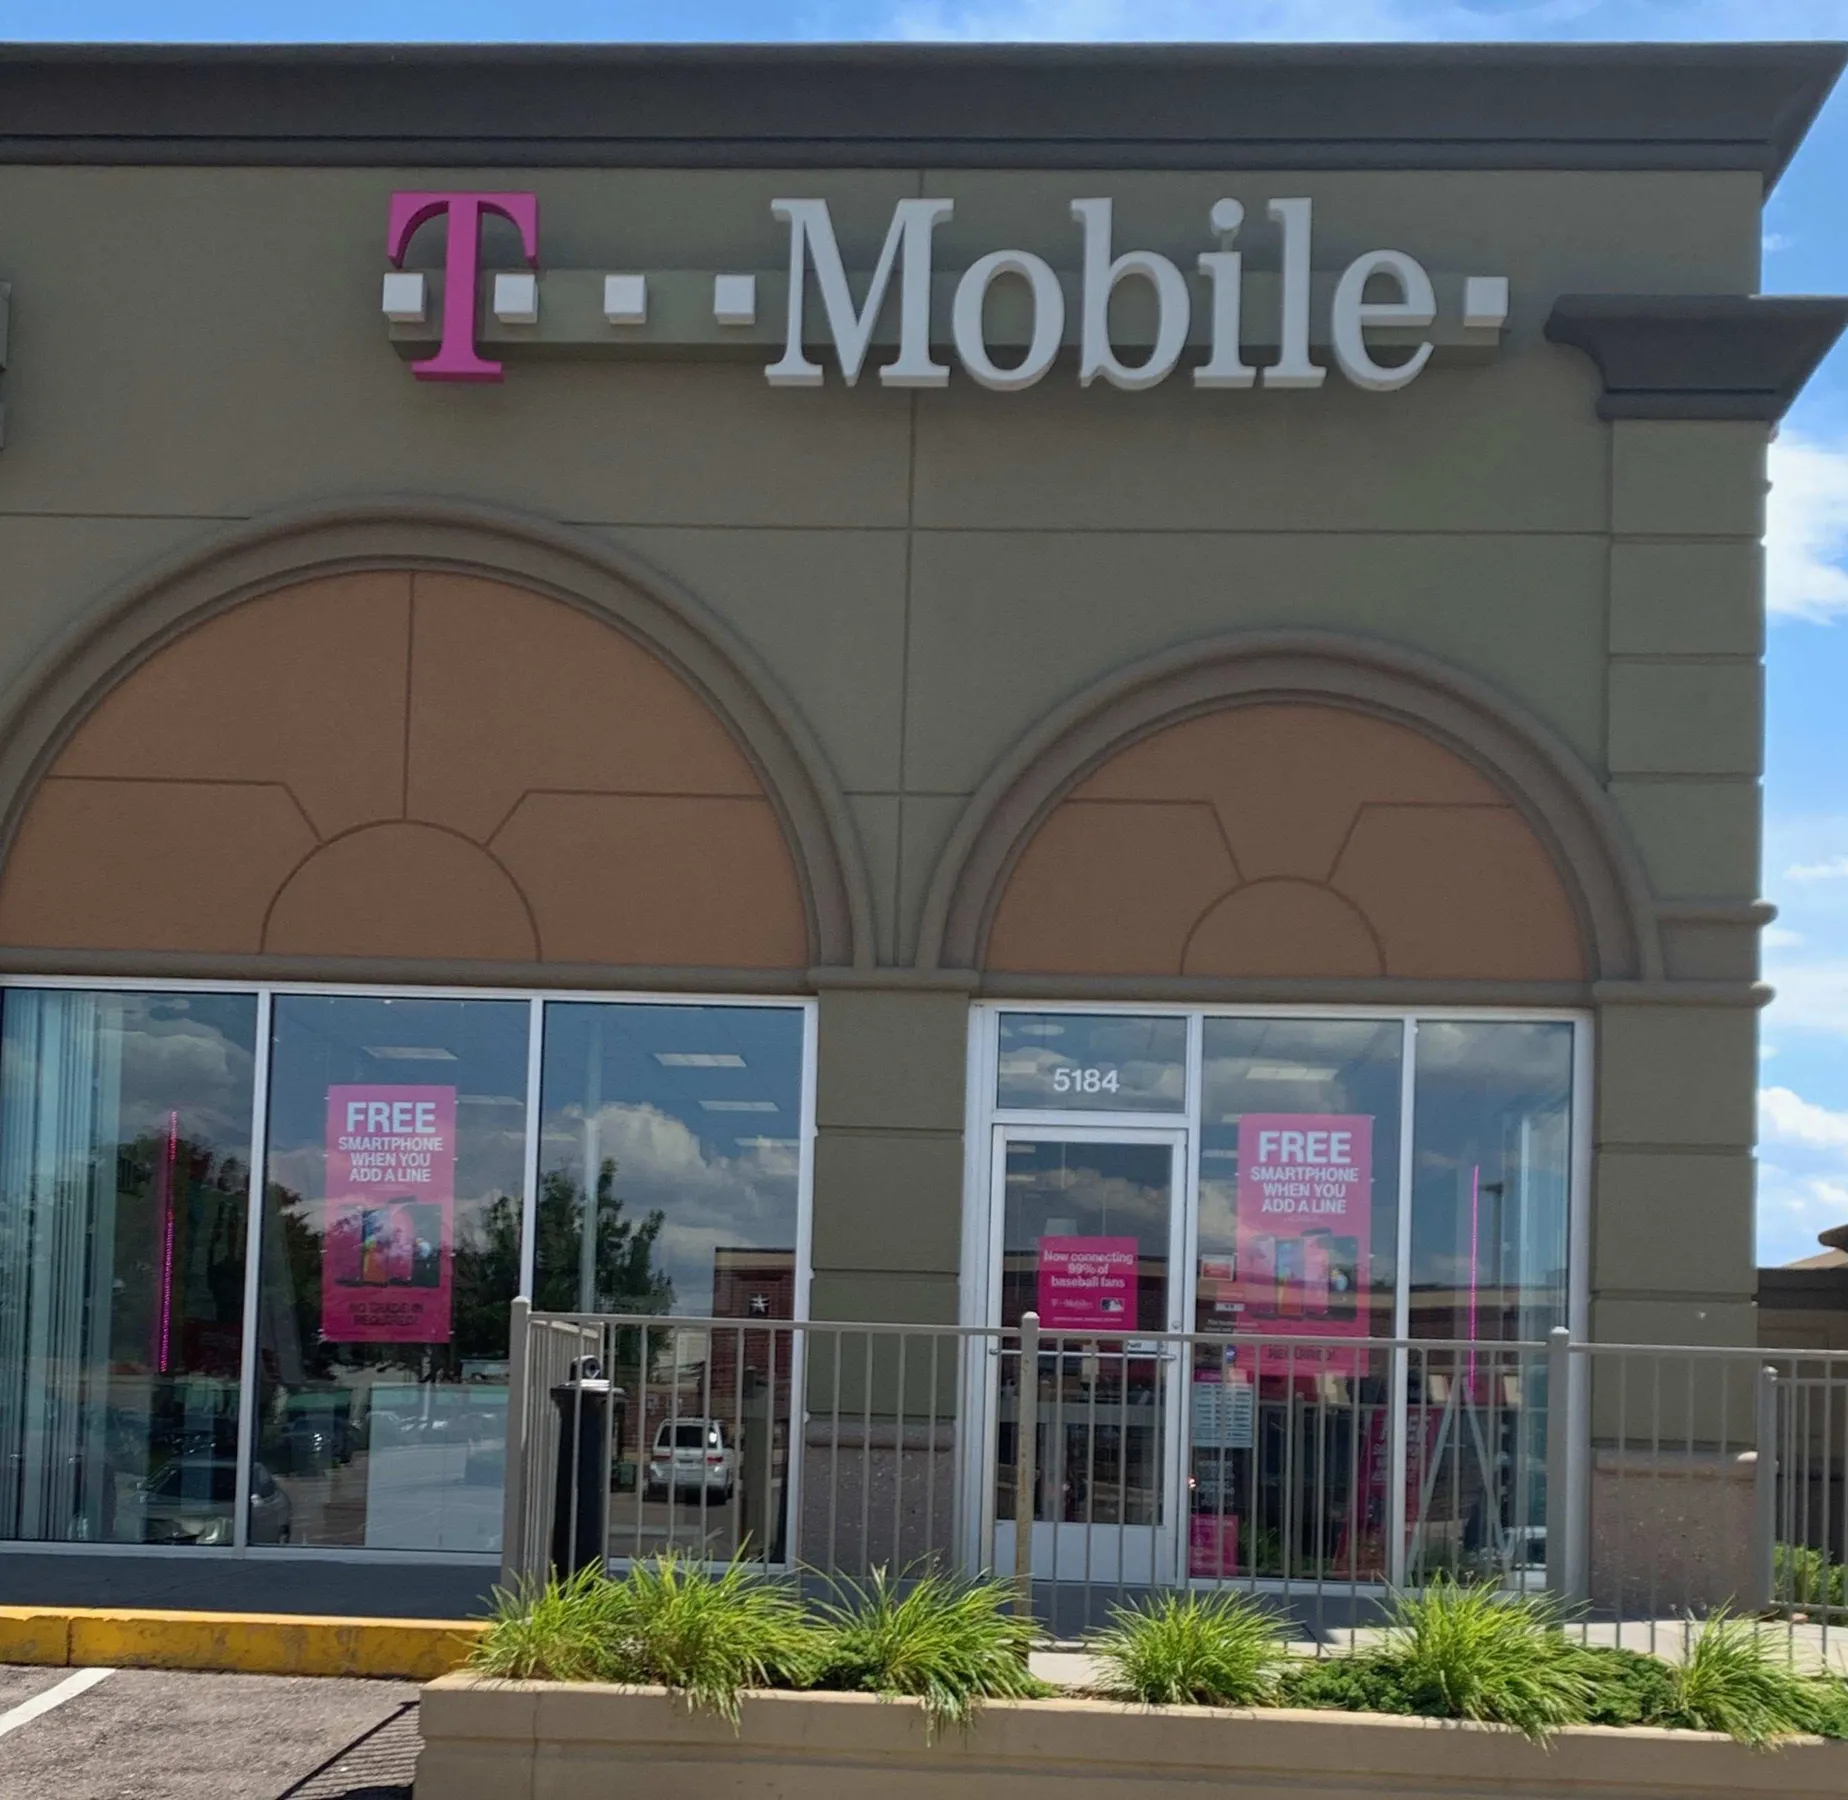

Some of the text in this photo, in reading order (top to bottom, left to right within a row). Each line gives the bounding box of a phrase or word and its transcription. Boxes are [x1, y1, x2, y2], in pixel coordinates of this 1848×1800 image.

[1053, 1068, 1120, 1093] 5184
[347, 1101, 436, 1133] FREE
[338, 1136, 444, 1151] SMARTPHONE
[1259, 1131, 1352, 1164] FREE
[350, 1151, 431, 1167] WHEN YOU
[349, 1167, 432, 1183] ADD A LINE
[1250, 1166, 1360, 1183] SMARTPHONE
[1263, 1182, 1346, 1198] WHEN YOU
[1261, 1199, 1347, 1214] ADD A LINE
[1044, 1250, 1133, 1265] Now connecting
[1098, 1263, 1110, 1274] of
[1051, 1276, 1125, 1288] baseball fans
